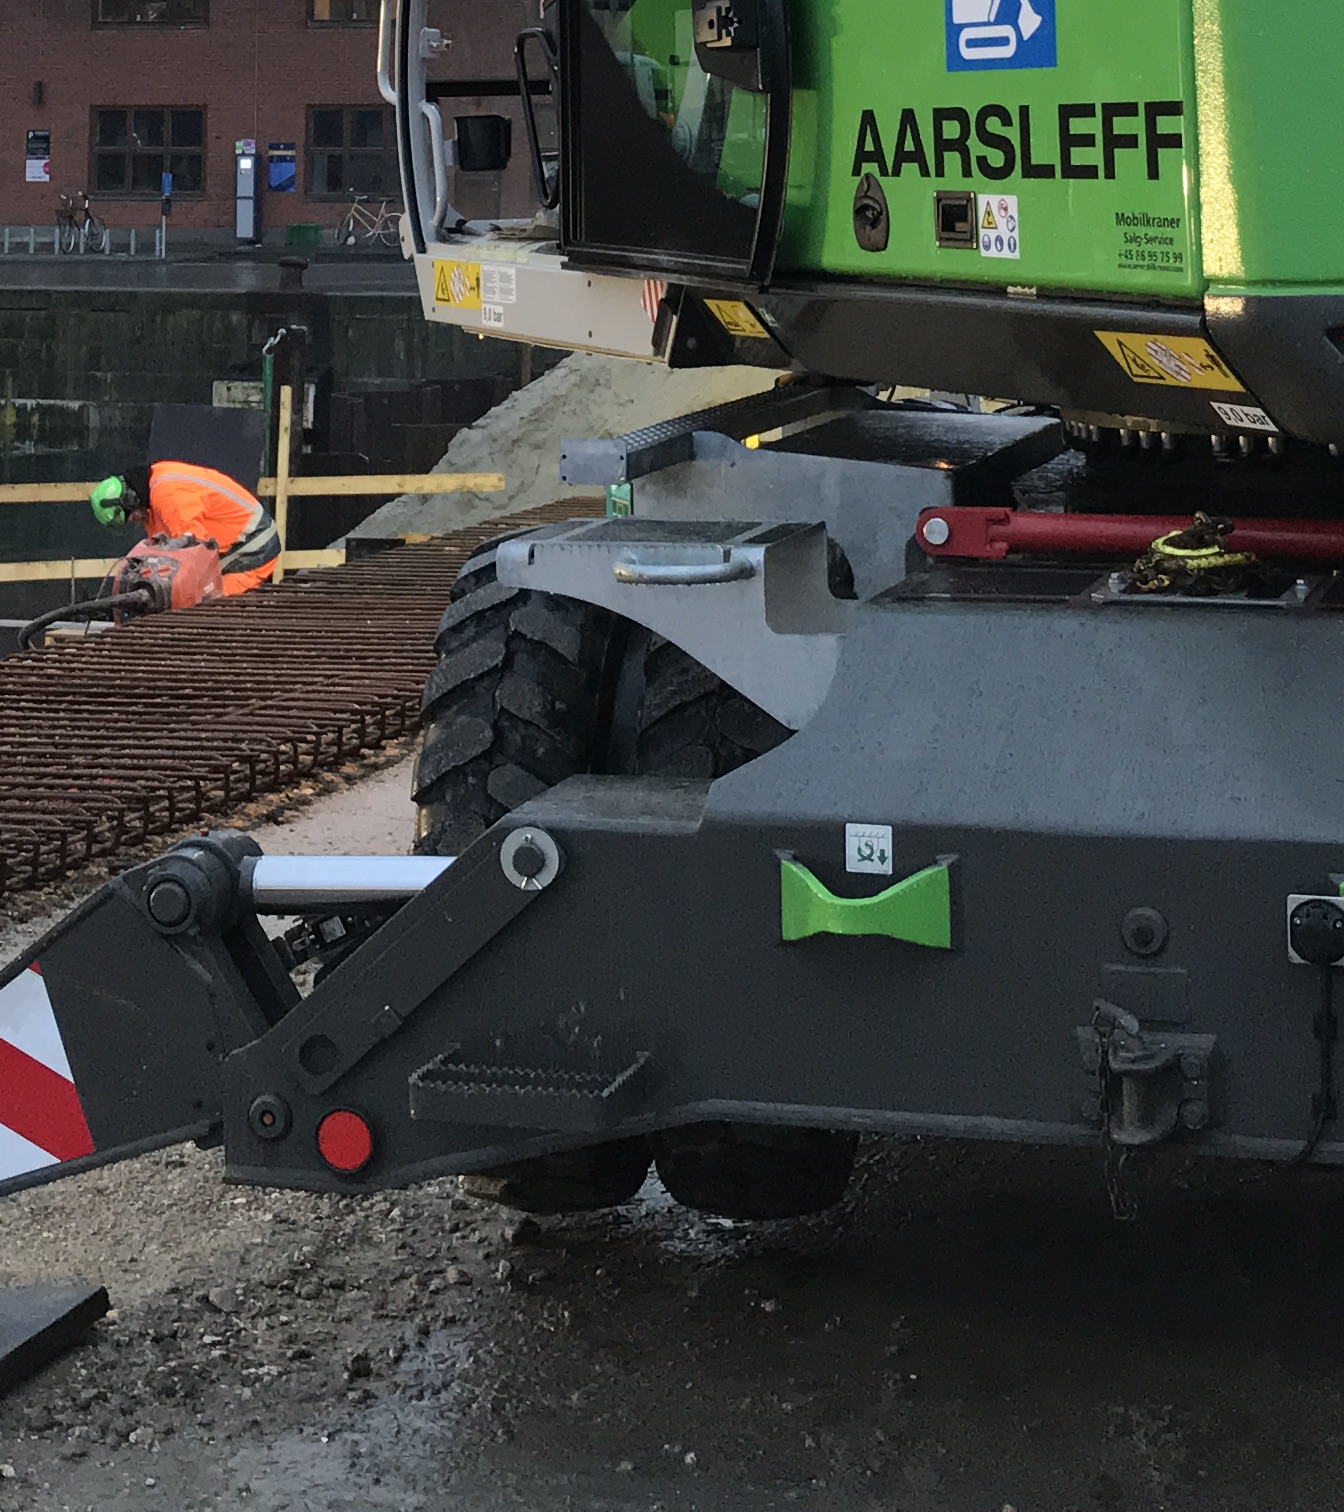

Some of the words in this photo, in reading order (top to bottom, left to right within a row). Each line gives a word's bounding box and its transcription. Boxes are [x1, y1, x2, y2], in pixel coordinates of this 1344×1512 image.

[851, 100, 1184, 181] AARSLEFF
[1115, 212, 1181, 229] Mobilkraner
[1217, 406, 1244, 424] 9,0
[1240, 408, 1270, 426] bar
